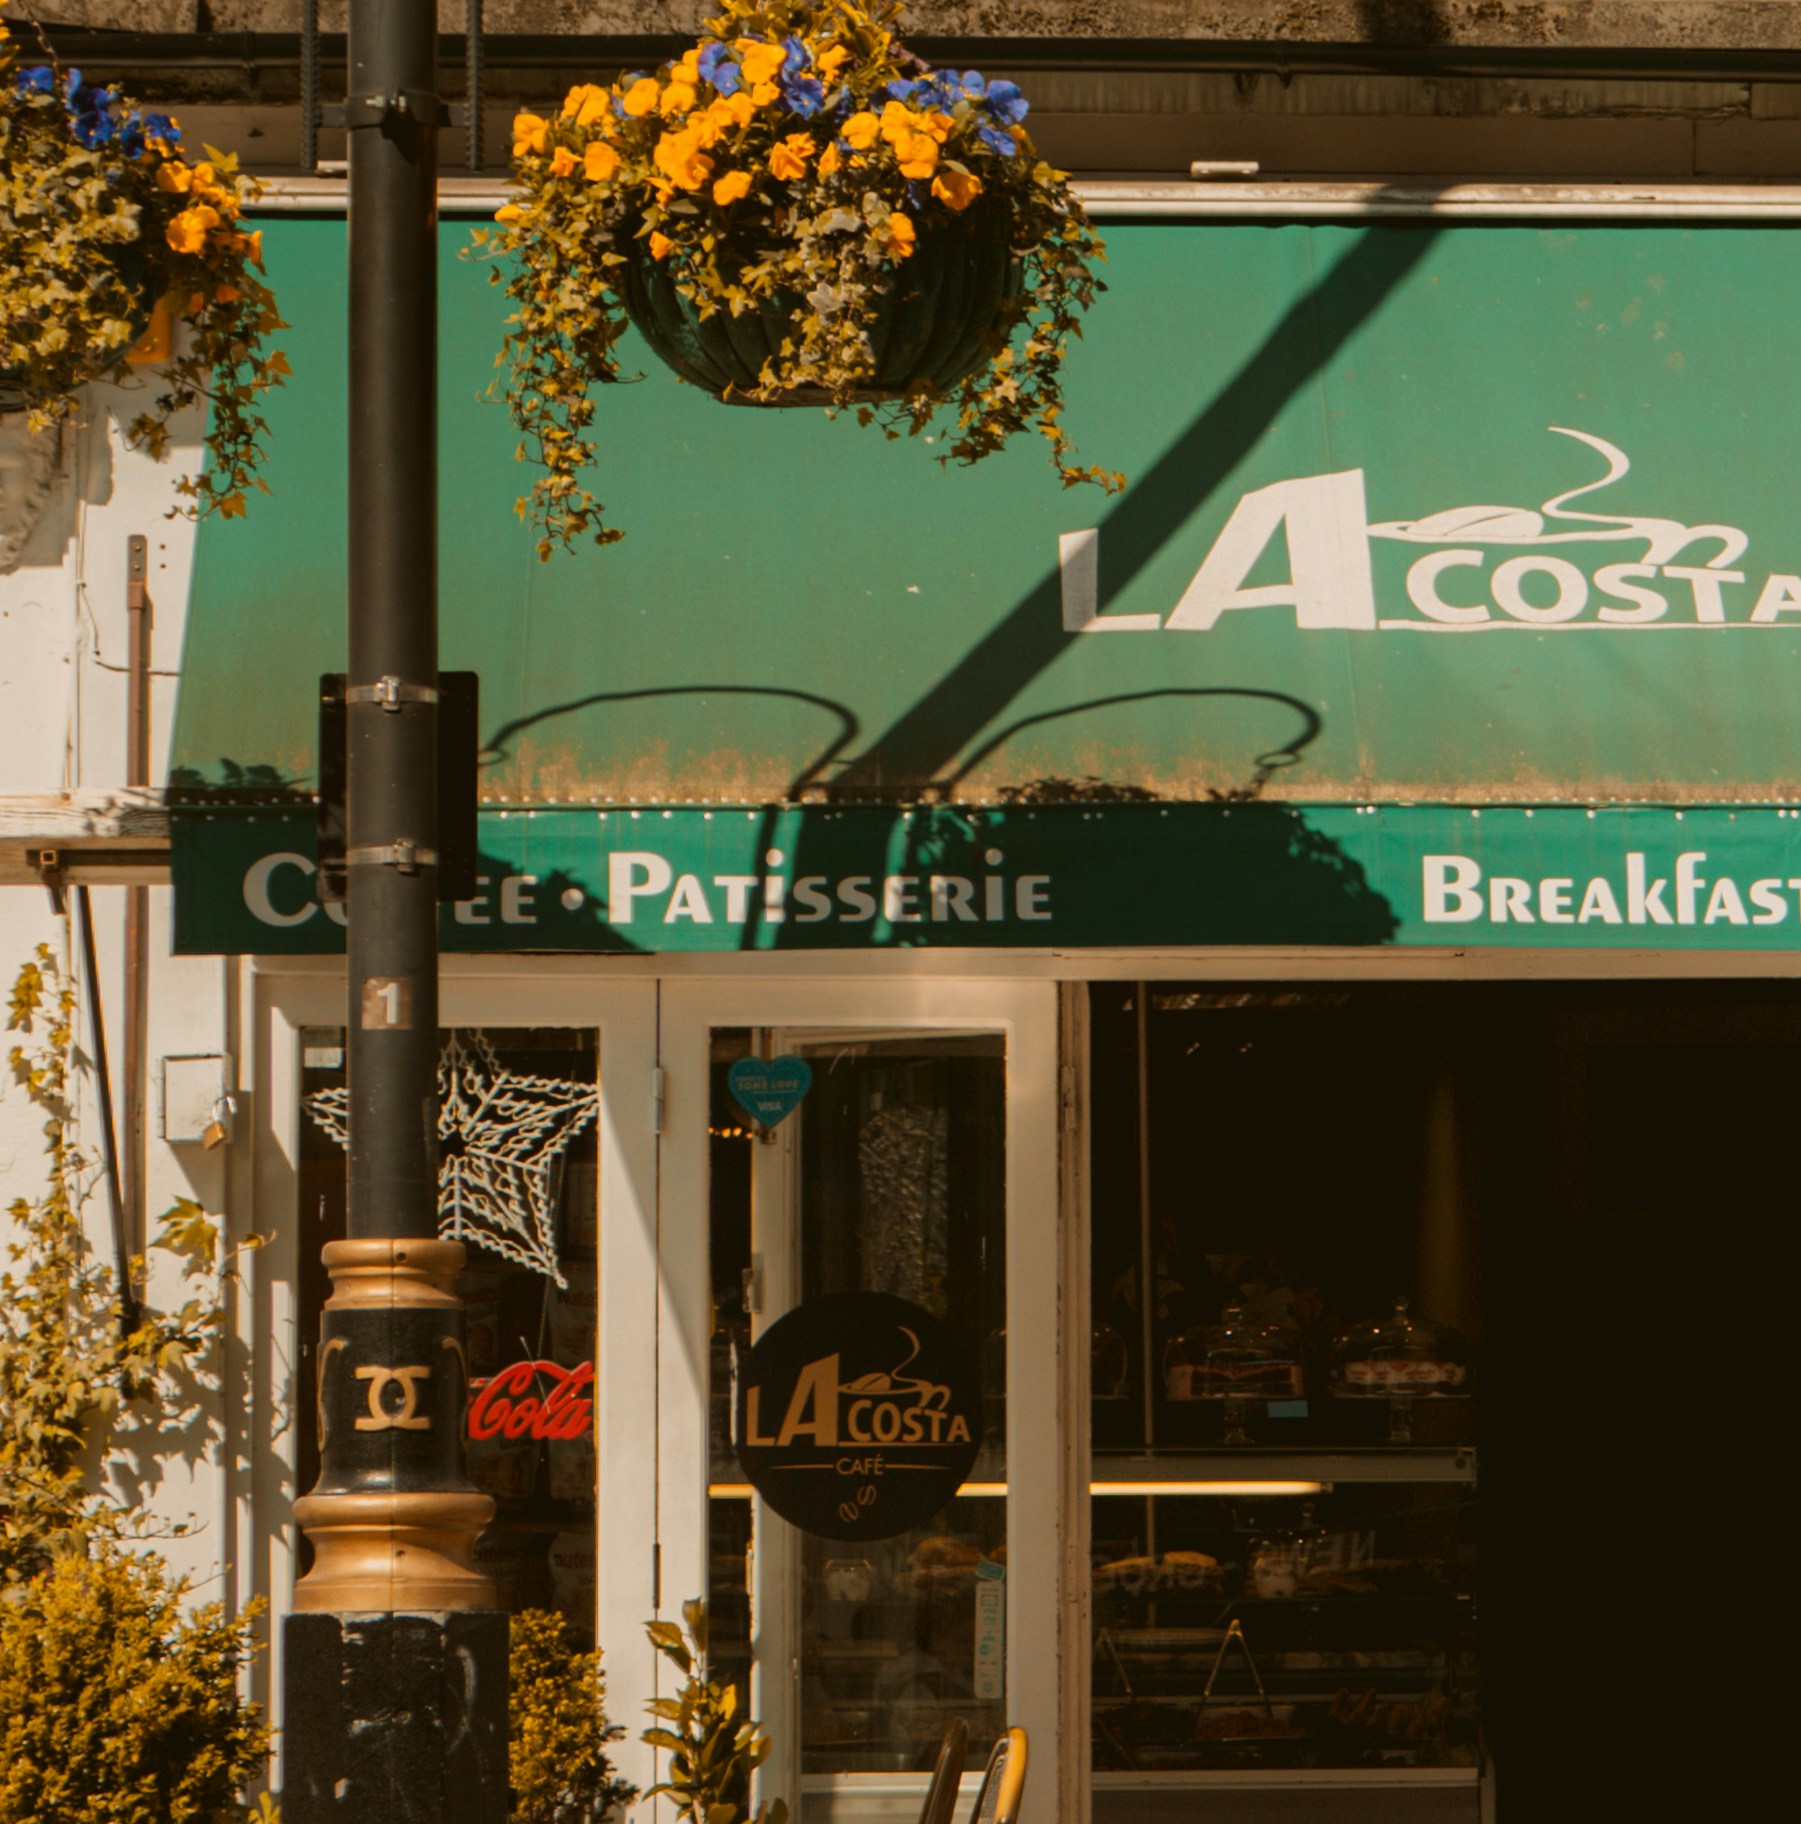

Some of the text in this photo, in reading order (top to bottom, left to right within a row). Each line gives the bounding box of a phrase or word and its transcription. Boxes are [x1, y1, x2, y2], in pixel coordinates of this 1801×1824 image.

[1058, 467, 1378, 632] LA
[376, 982, 397, 1025] 1
[746, 1352, 972, 1447] LA COSTA
[836, 1454, 885, 1476] CAFÉ
